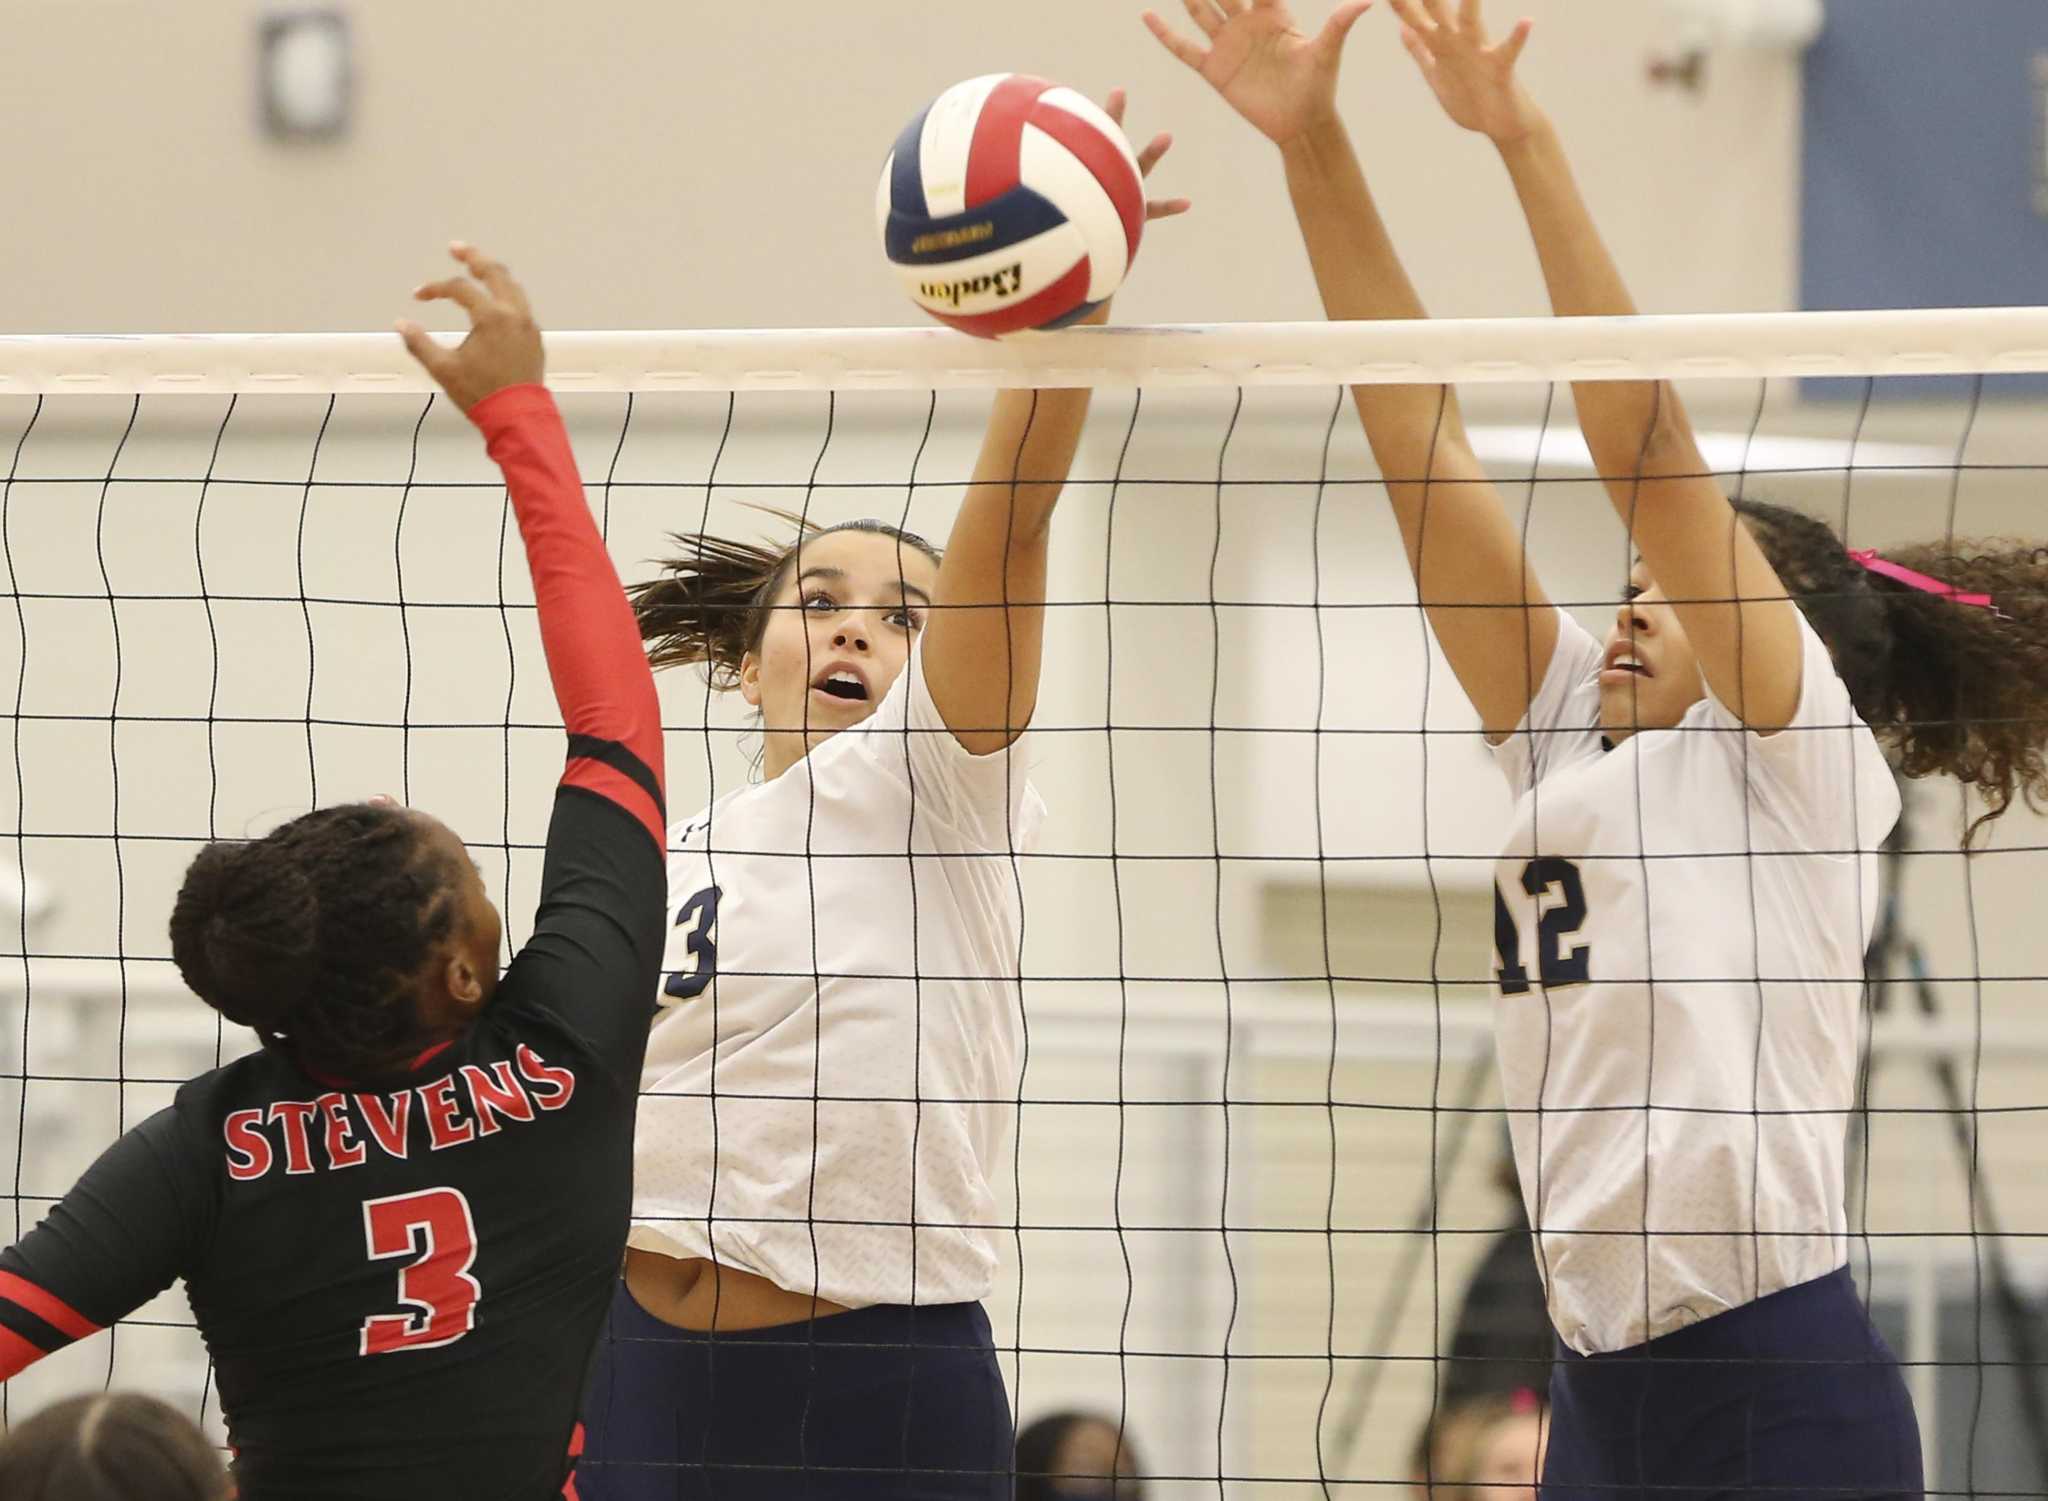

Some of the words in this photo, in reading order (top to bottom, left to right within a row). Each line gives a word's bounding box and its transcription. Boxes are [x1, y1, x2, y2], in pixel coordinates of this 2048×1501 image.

[920, 263, 1021, 306] Baden
[1494, 856, 1591, 996] 12
[224, 1043, 575, 1181] STEVENS
[360, 1186, 482, 1356] 3
